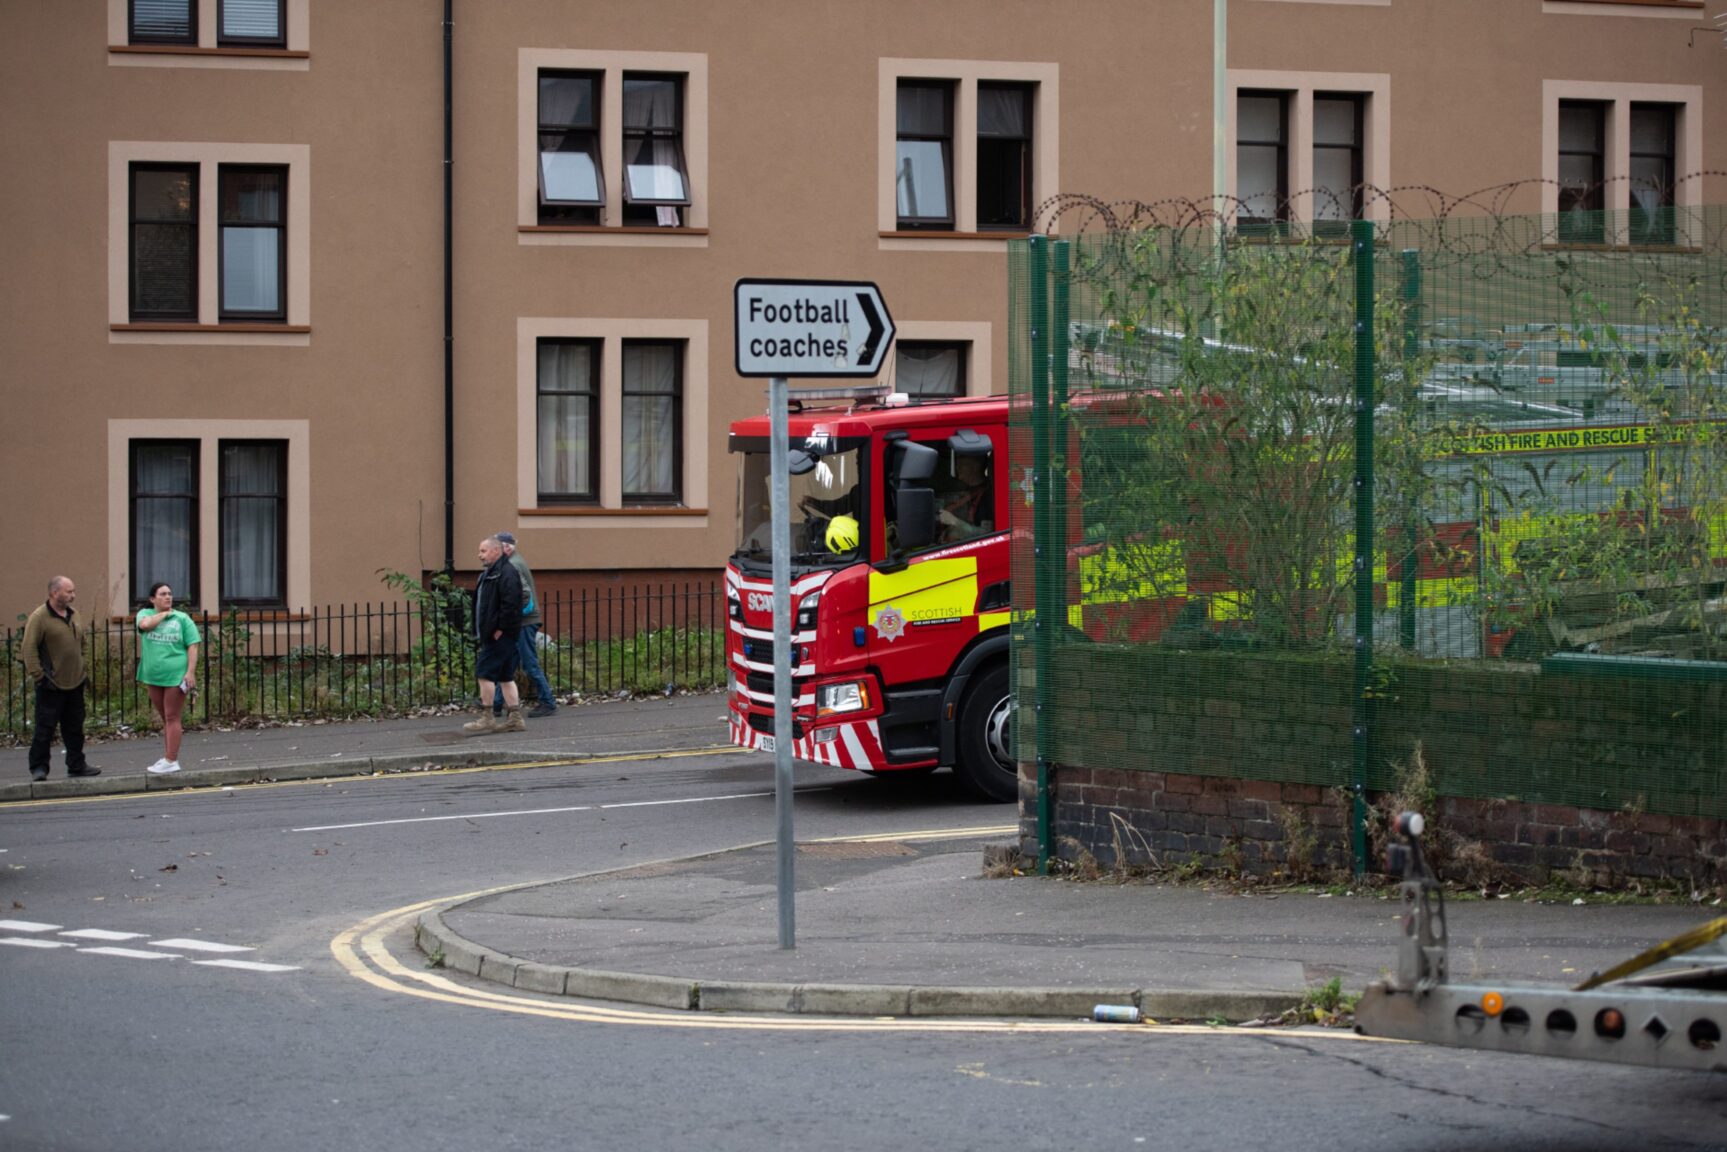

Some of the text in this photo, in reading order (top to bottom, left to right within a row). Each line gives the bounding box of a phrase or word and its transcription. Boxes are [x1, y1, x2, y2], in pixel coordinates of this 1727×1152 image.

[750, 298, 849, 323] Football
[750, 332, 848, 357] coaches
[1509, 433, 1541, 450] FIRE
[1545, 430, 1579, 448] AND
[1583, 427, 1639, 446] RESCUE
[911, 607, 962, 620] SCOTTISH
